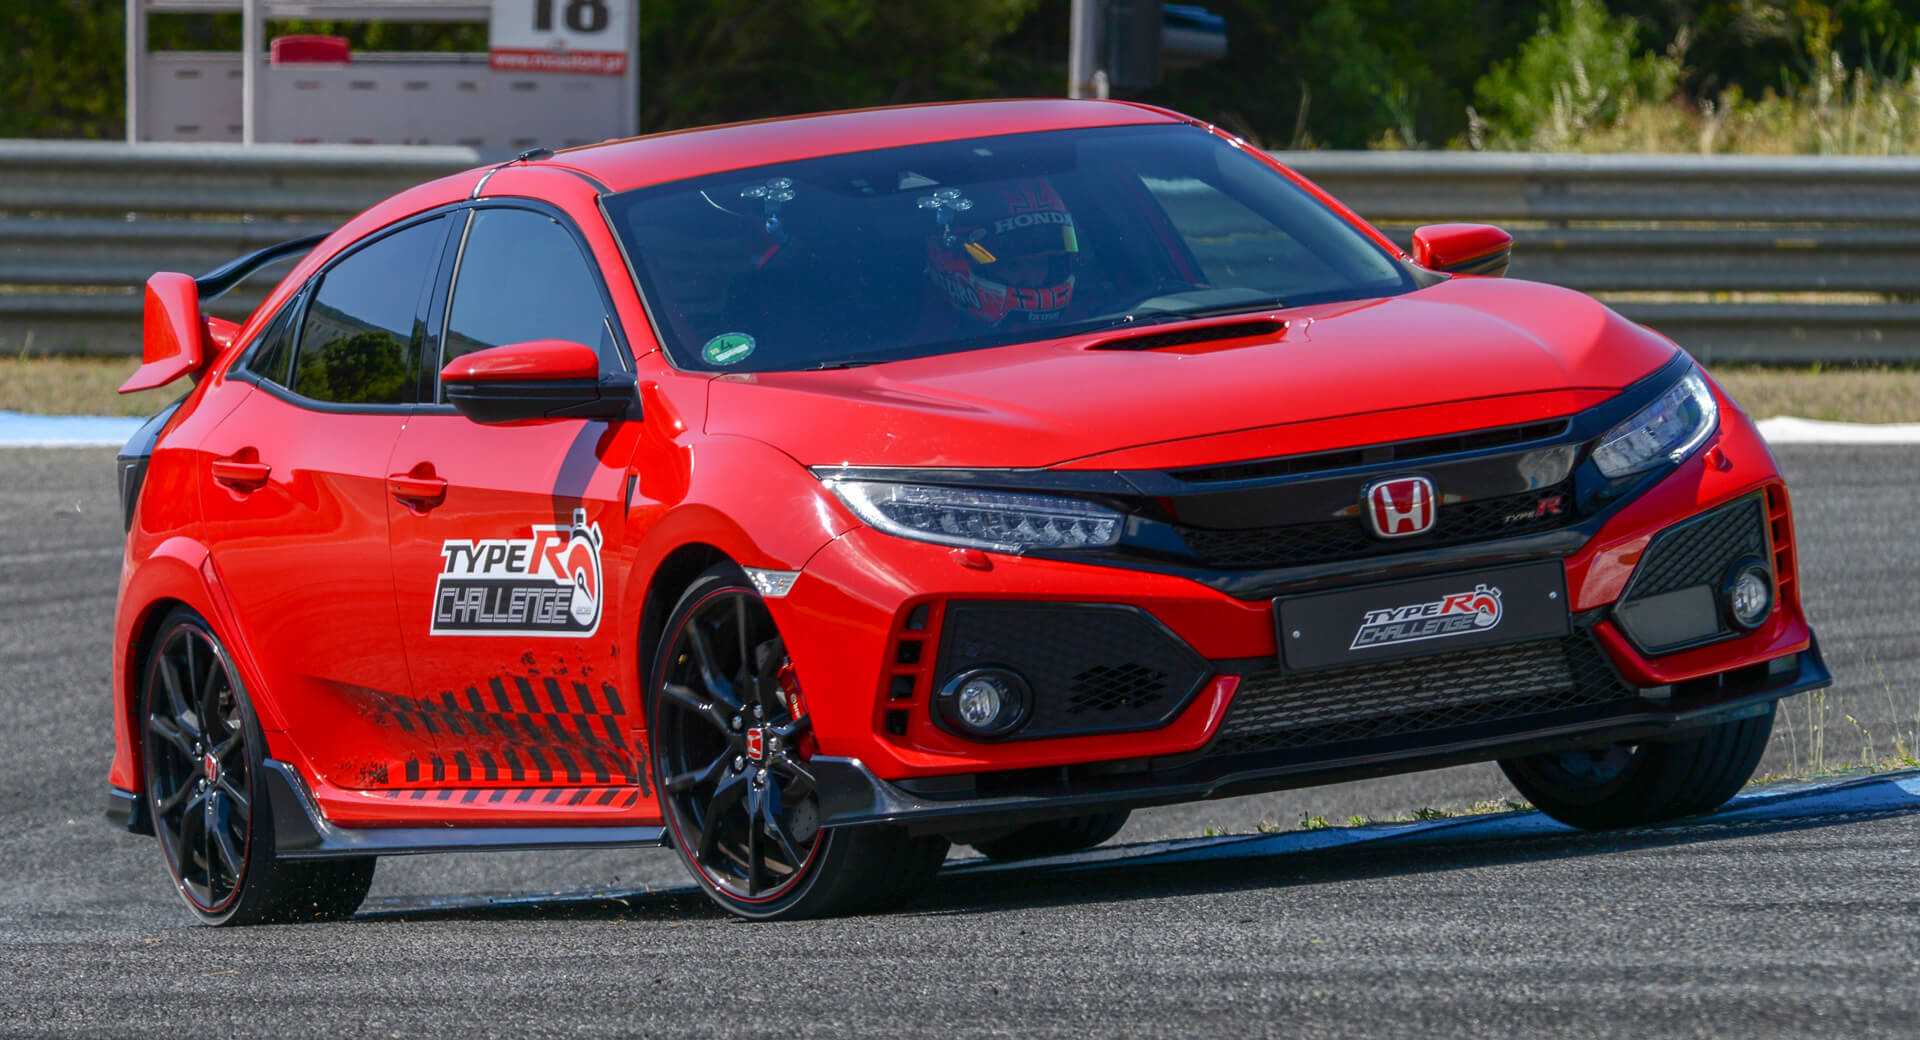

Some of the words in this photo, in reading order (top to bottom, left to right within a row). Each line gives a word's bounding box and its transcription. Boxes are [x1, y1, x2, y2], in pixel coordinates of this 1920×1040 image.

[1538, 498, 1560, 515] R
[445, 544, 527, 573] TYPE
[528, 531, 572, 579] R
[437, 587, 572, 624] CHALLENGE
[1367, 604, 1439, 624] TYPE
[1440, 593, 1474, 614] R
[1358, 615, 1476, 644] CHALLENGE
